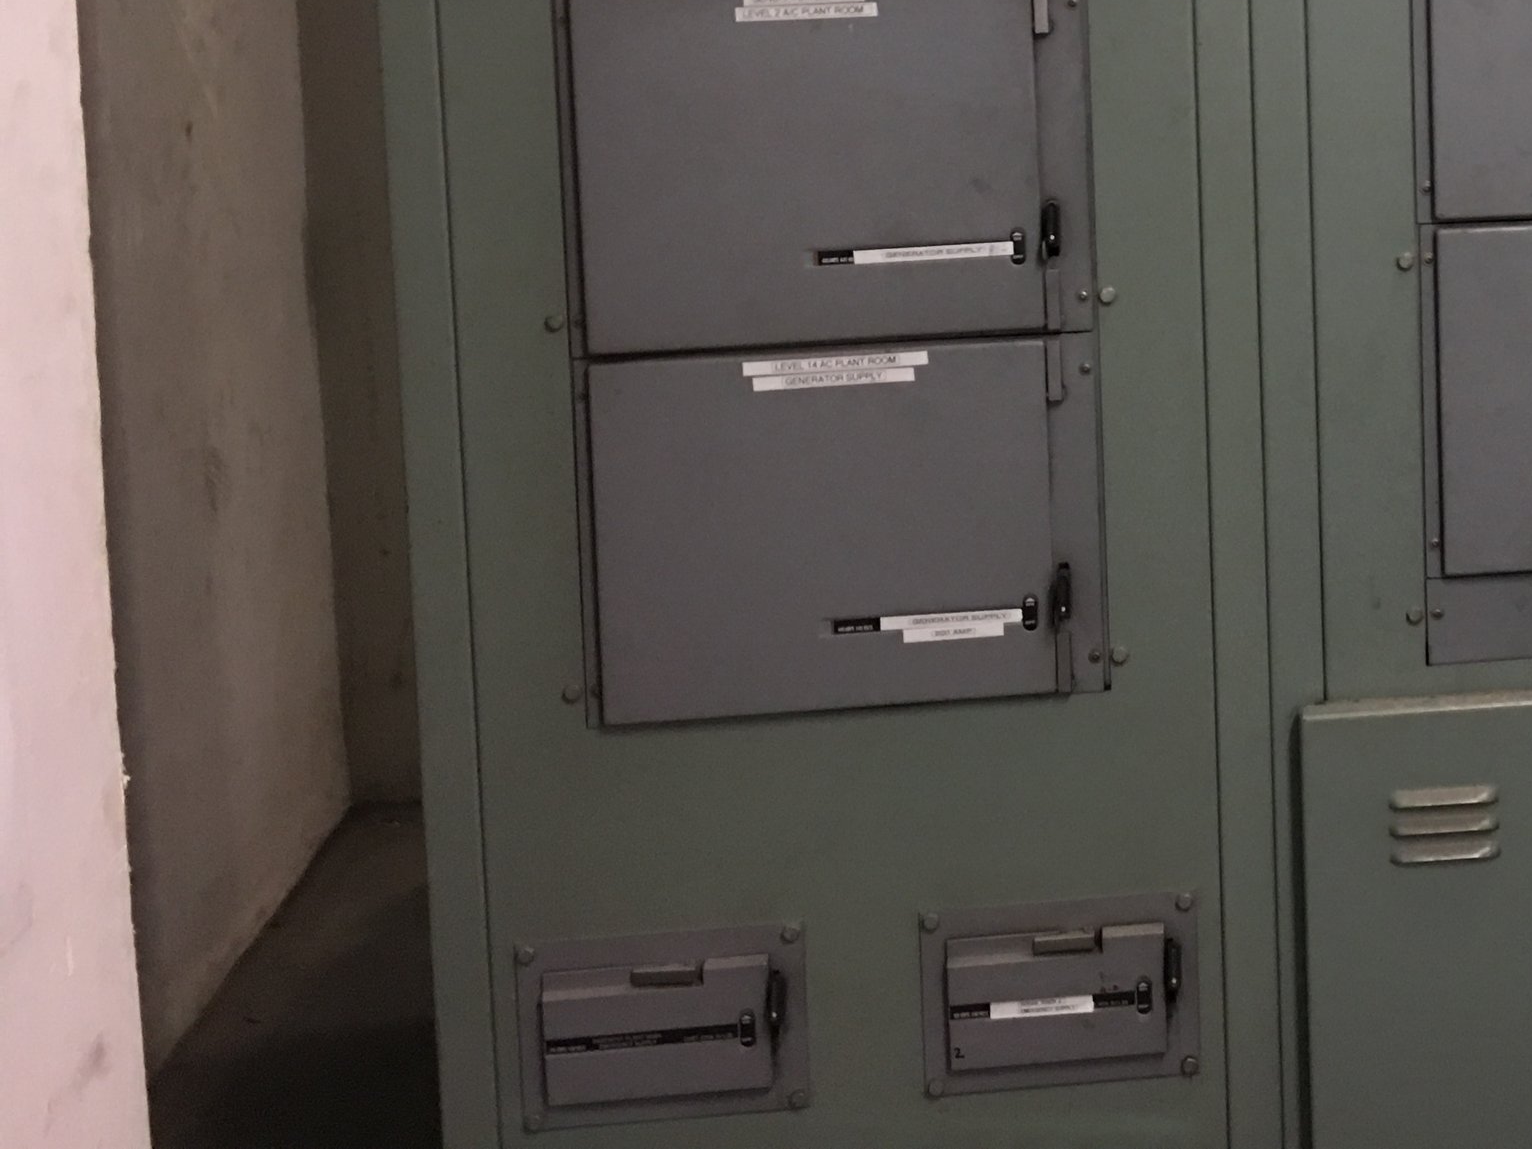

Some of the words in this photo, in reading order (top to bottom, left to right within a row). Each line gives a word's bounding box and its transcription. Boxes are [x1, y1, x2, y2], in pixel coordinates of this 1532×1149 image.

[742, 7, 771, 18] LEVEL
[801, 5, 830, 15] PLANT
[834, 3, 865, 14] ROOM
[775, 362, 804, 372] LEVEL
[808, 361, 817, 369] 14
[835, 358, 865, 367] PLANT
[868, 355, 897, 365] ROOM
[785, 374, 843, 387] GENERATOR
[846, 371, 882, 382] SUPPLY
[954, 1047, 965, 1059] 2
